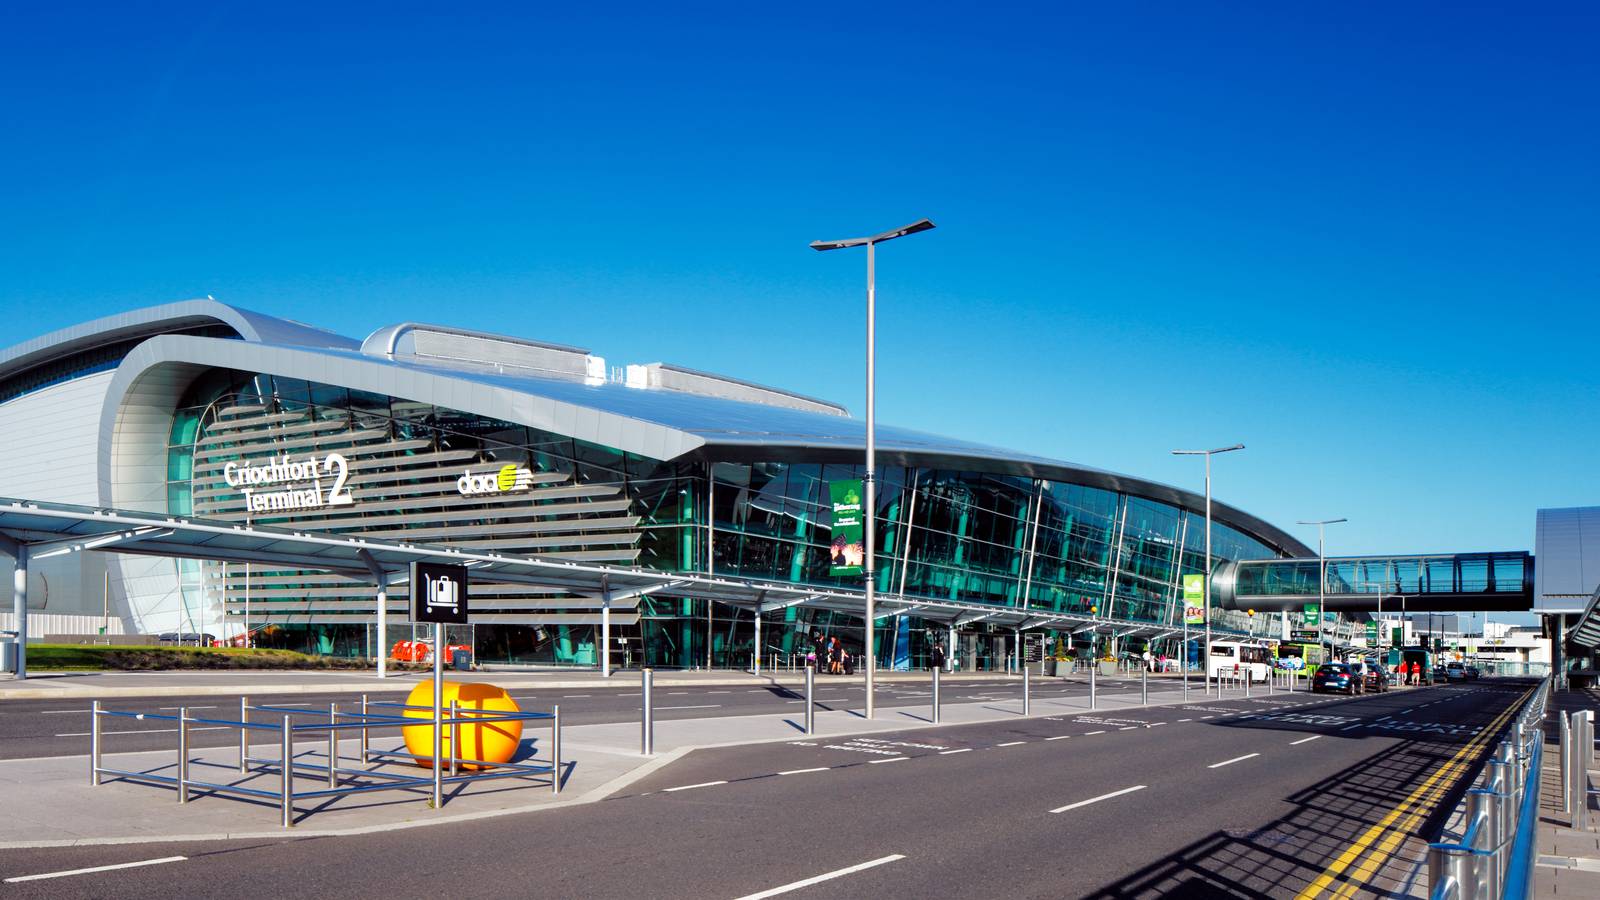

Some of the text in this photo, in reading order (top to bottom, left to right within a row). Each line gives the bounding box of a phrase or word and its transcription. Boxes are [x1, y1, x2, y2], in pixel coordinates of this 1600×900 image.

[224, 454, 320, 487] Críochfort
[241, 453, 353, 512] Terminal 2
[457, 469, 502, 494] daa
